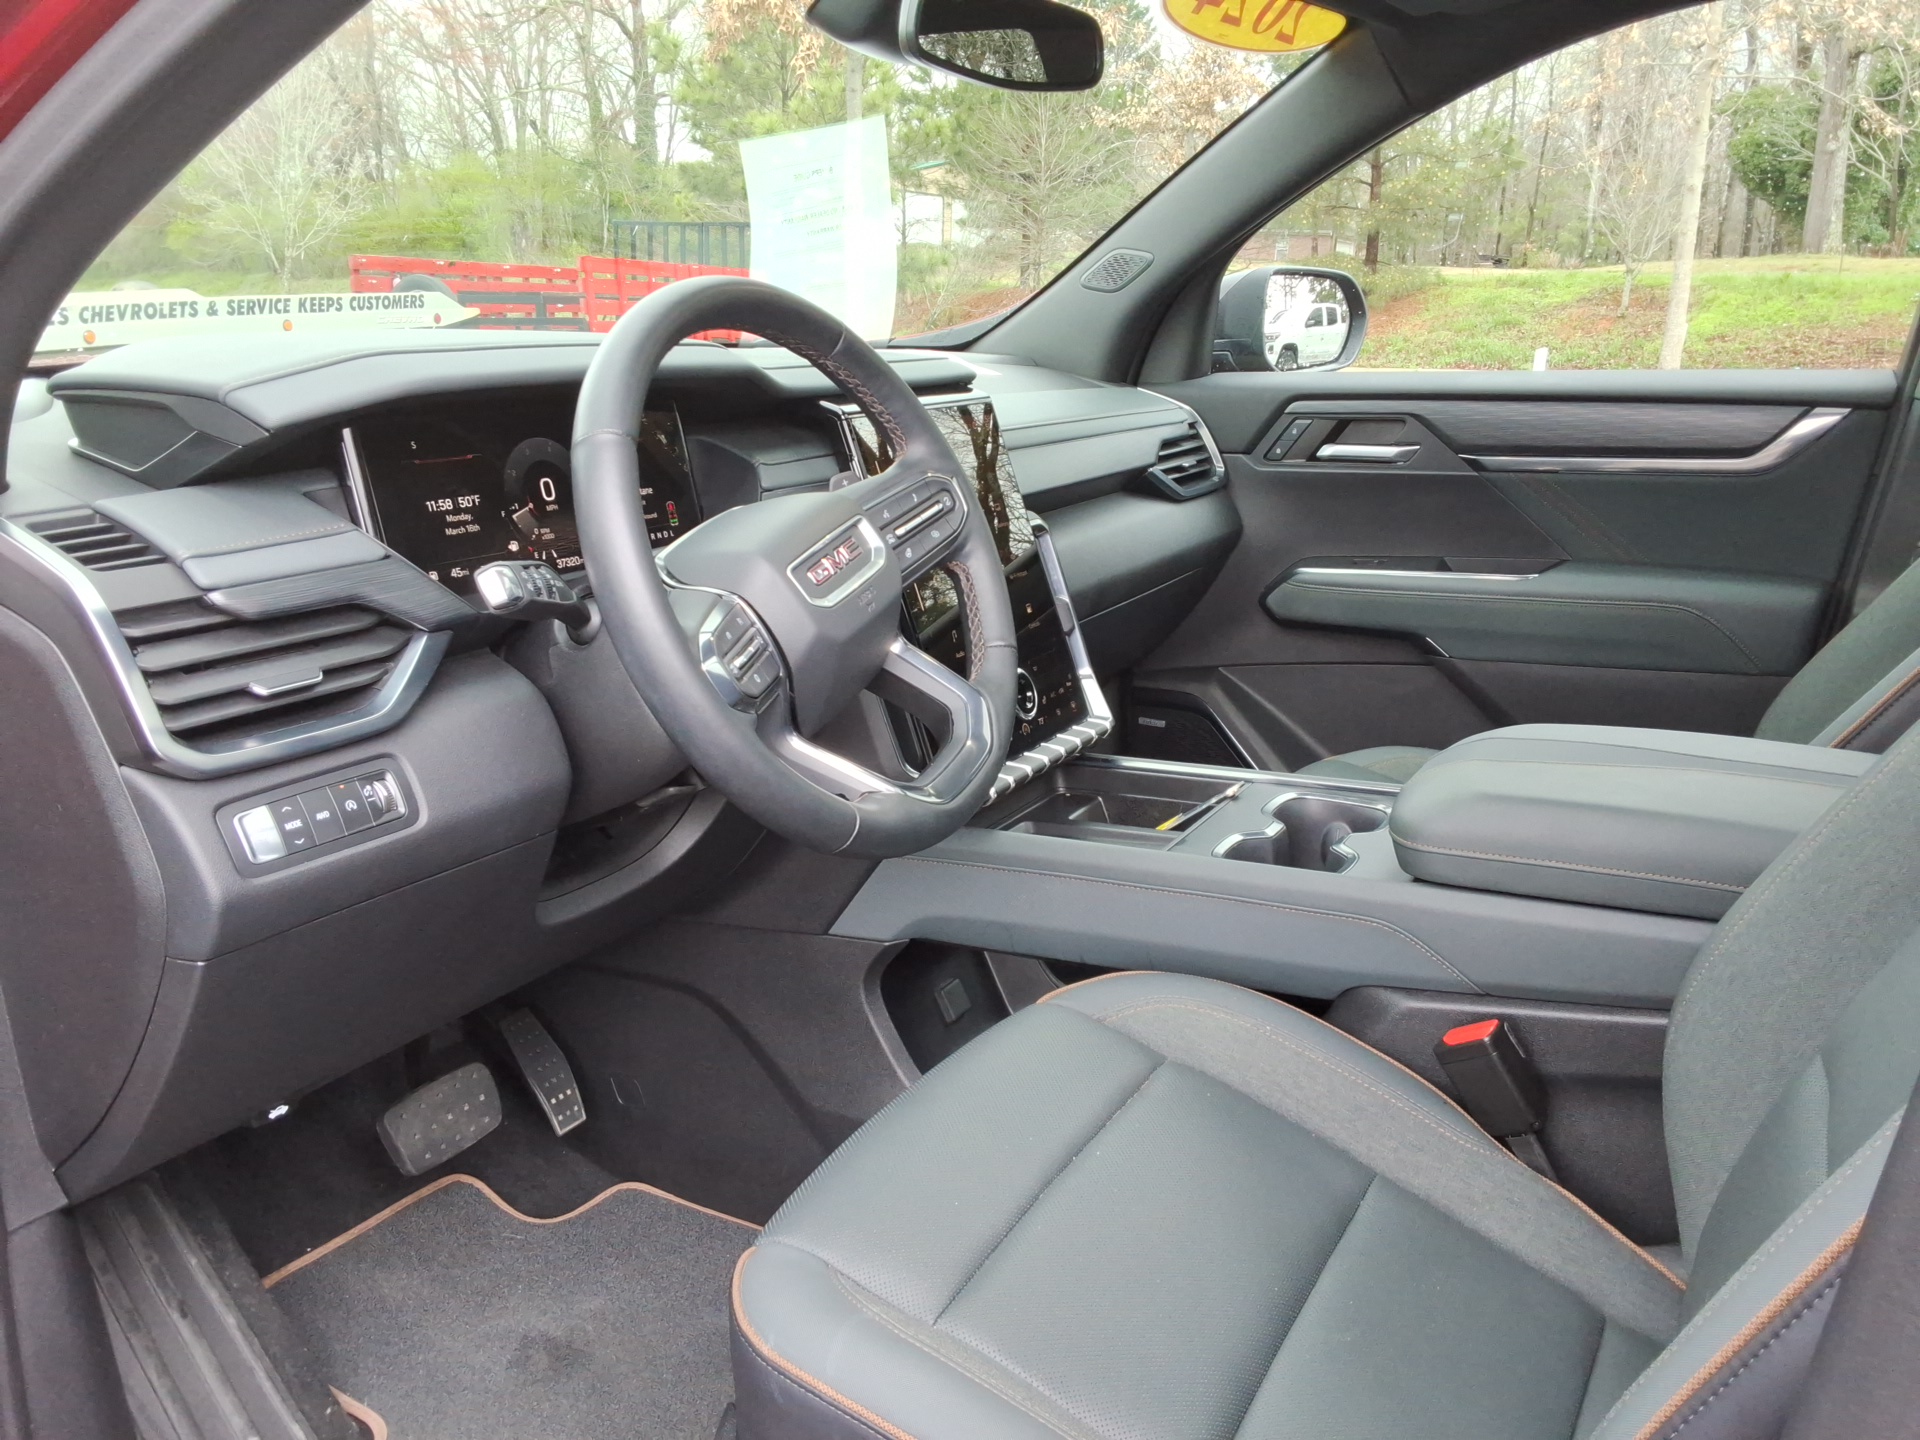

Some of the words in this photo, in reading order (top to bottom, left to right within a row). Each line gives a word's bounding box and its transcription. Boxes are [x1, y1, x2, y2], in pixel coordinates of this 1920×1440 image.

[78, 300, 199, 324] CHEVROLETS
[206, 300, 219, 316] &
[226, 297, 291, 316] SERVICE
[298, 296, 344, 313] KEEPS
[349, 294, 425, 312] CUSTOMERS
[539, 477, 556, 501] 0
[425, 498, 453, 512] 11:58
[457, 494, 481, 508] 50°F
[445, 526, 466, 536] March
[806, 536, 864, 586] GMC
[284, 819, 302, 830] MODE
[316, 811, 330, 820] AWD
